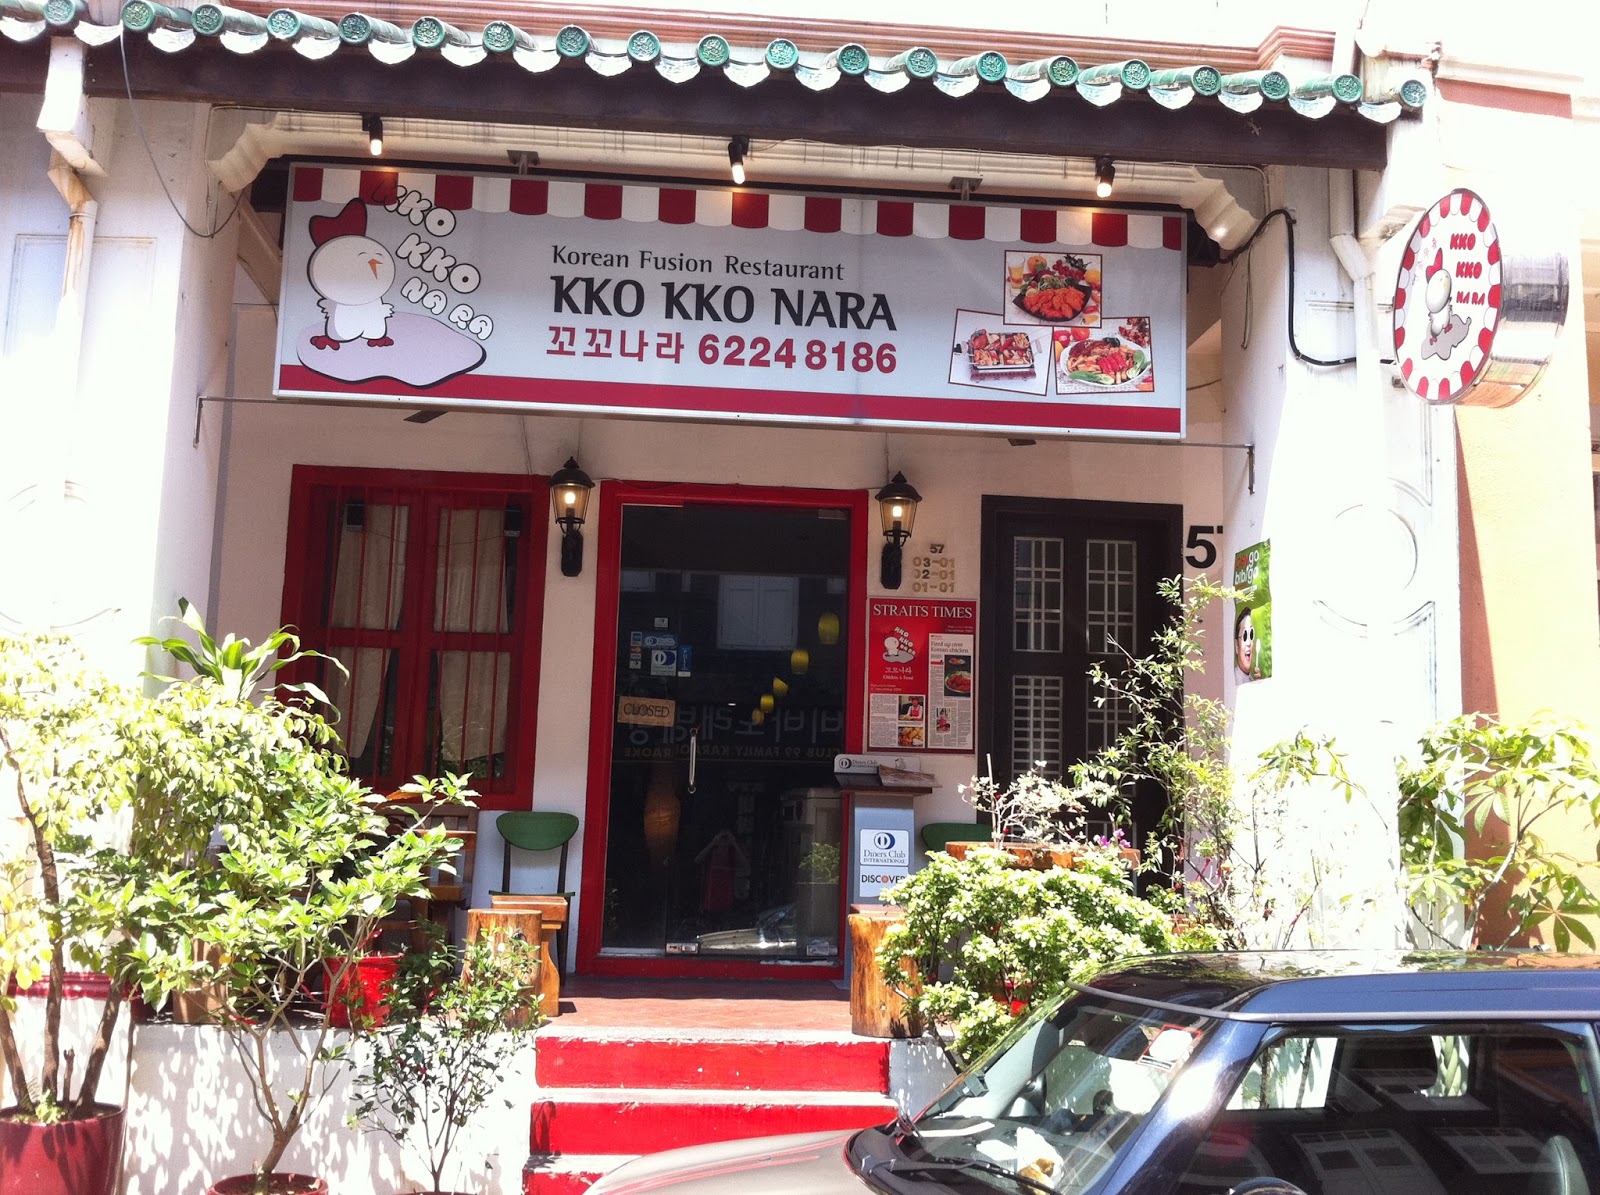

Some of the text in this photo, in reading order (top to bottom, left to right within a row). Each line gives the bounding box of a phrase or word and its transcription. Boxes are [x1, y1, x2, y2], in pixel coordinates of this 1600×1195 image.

[371, 180, 456, 237] KKO
[1450, 233, 1476, 250] KKO
[396, 233, 481, 294] KKO
[552, 245, 844, 280] Korean Fusion Restaurant
[1455, 261, 1482, 279] KKO
[550, 275, 897, 331] KKO KKO NARA
[546, 325, 897, 374] 꼬꼬나라 6224 8186
[929, 543, 945, 554] 57
[1185, 525, 1224, 569] 5
[912, 556, 955, 568] 03-01
[912, 582, 955, 593] 01-01
[873, 604, 973, 619] STRAITS TIMES
[623, 702, 670, 719] CLOSED
[863, 849, 906, 858] Diners Club
